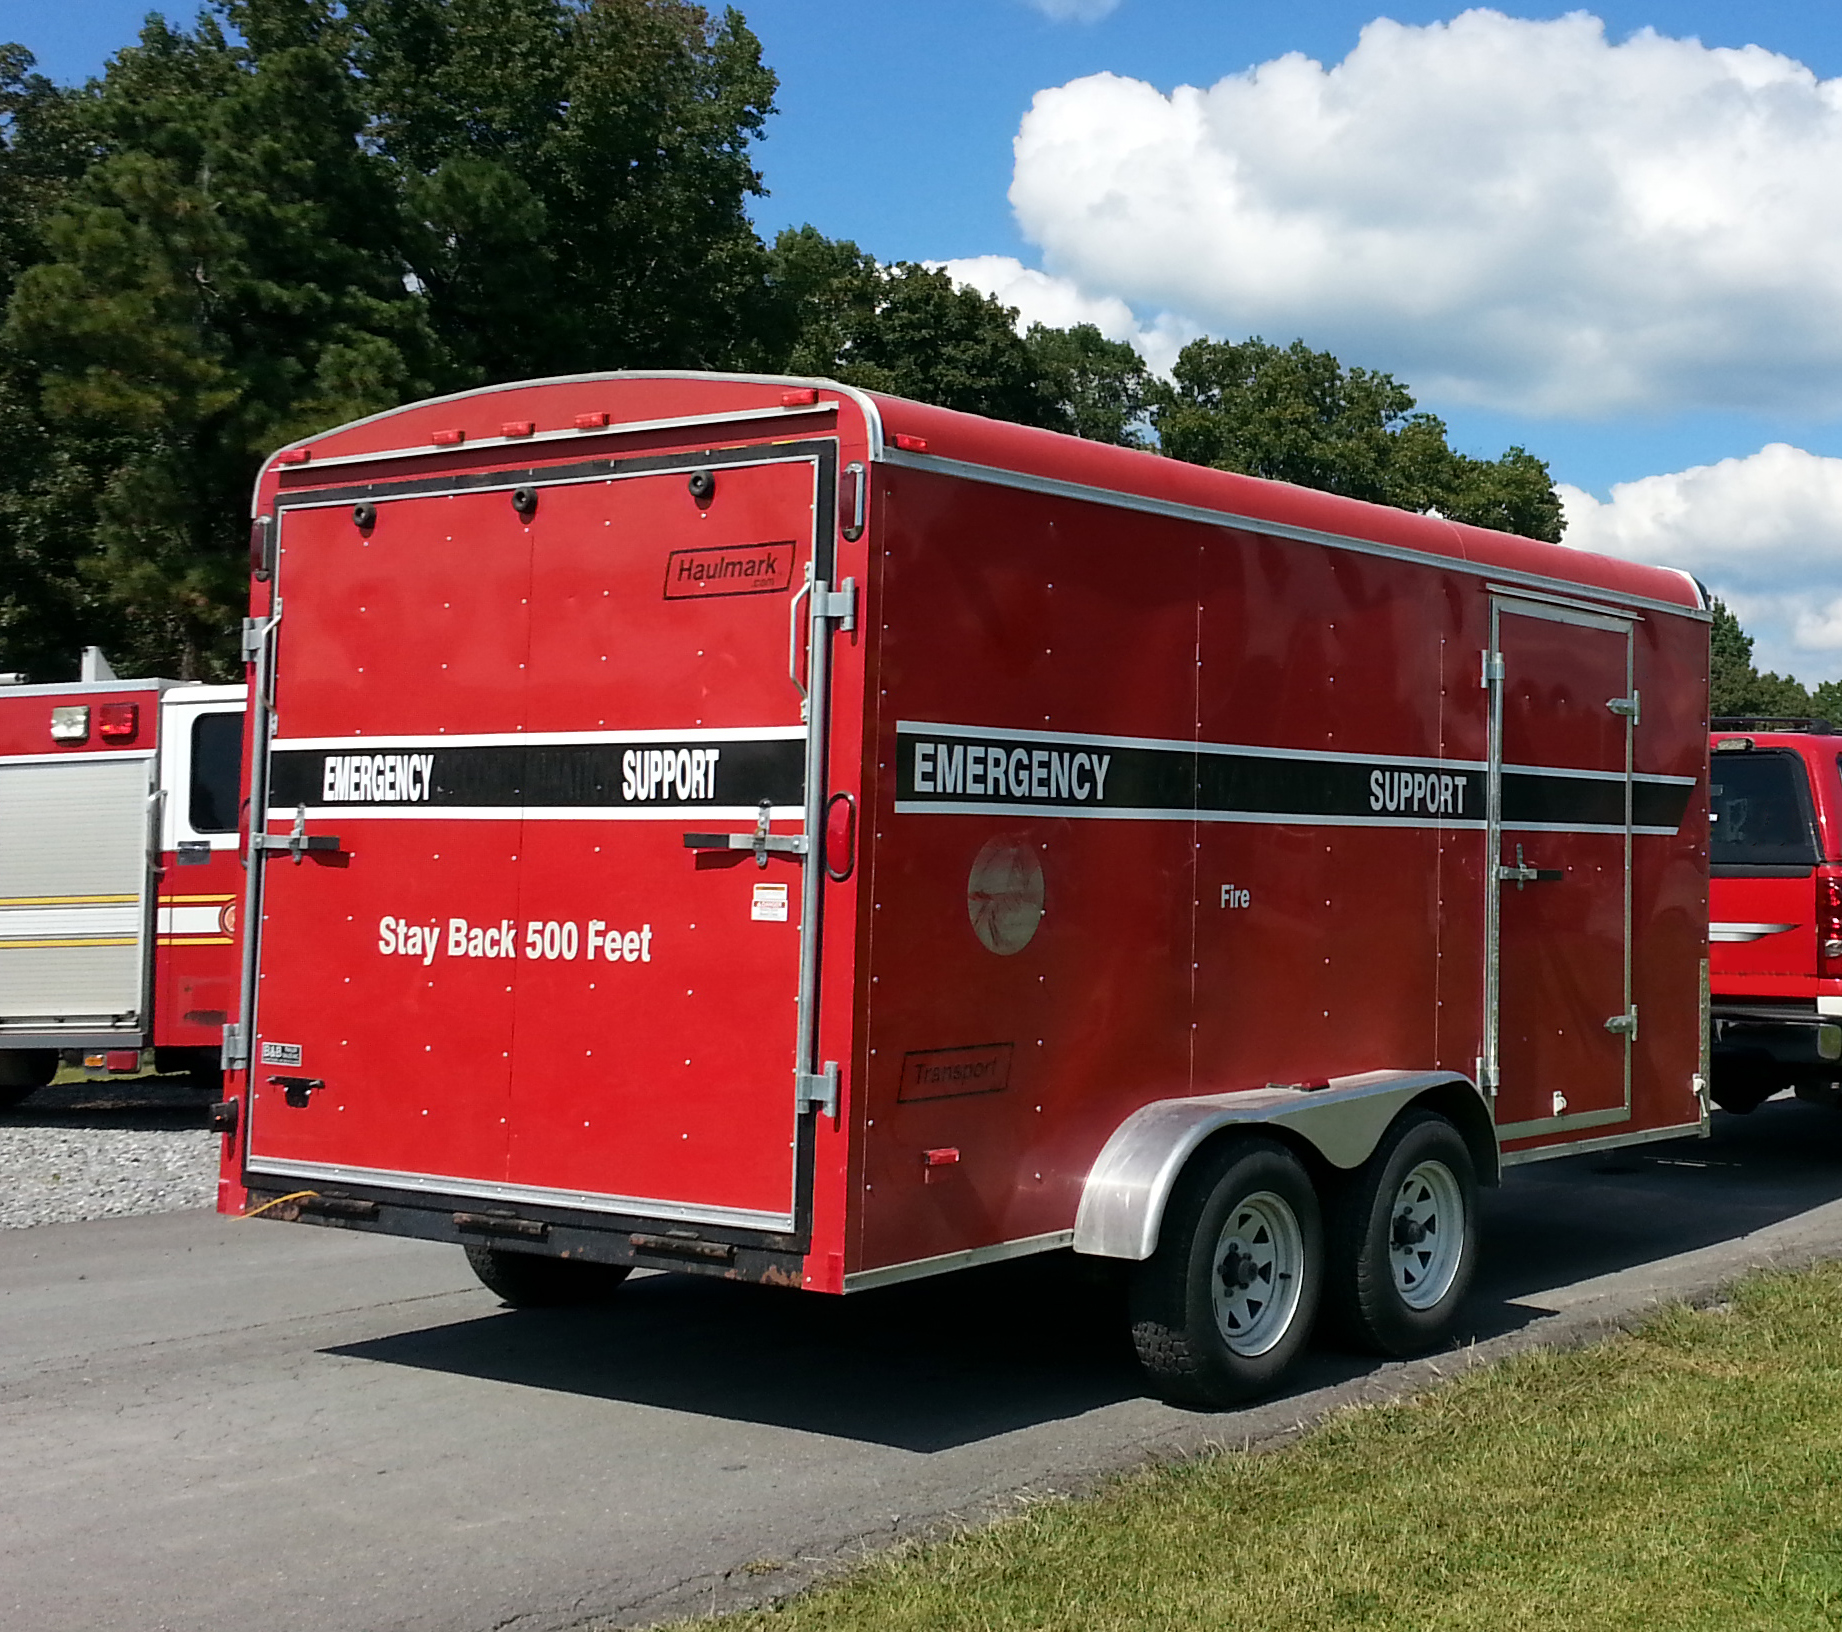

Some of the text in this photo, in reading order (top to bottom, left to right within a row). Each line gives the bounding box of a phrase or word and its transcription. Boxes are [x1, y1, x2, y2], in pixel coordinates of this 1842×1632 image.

[677, 552, 778, 582] Haulmark
[322, 749, 720, 802] EMERGENCY SUPPORT
[913, 742, 1468, 814] EMERGENCY SUPPORT
[1221, 884, 1250, 908] Fire
[378, 916, 652, 966] Stay Back 500 Feet
[915, 1056, 997, 1086] Transport
